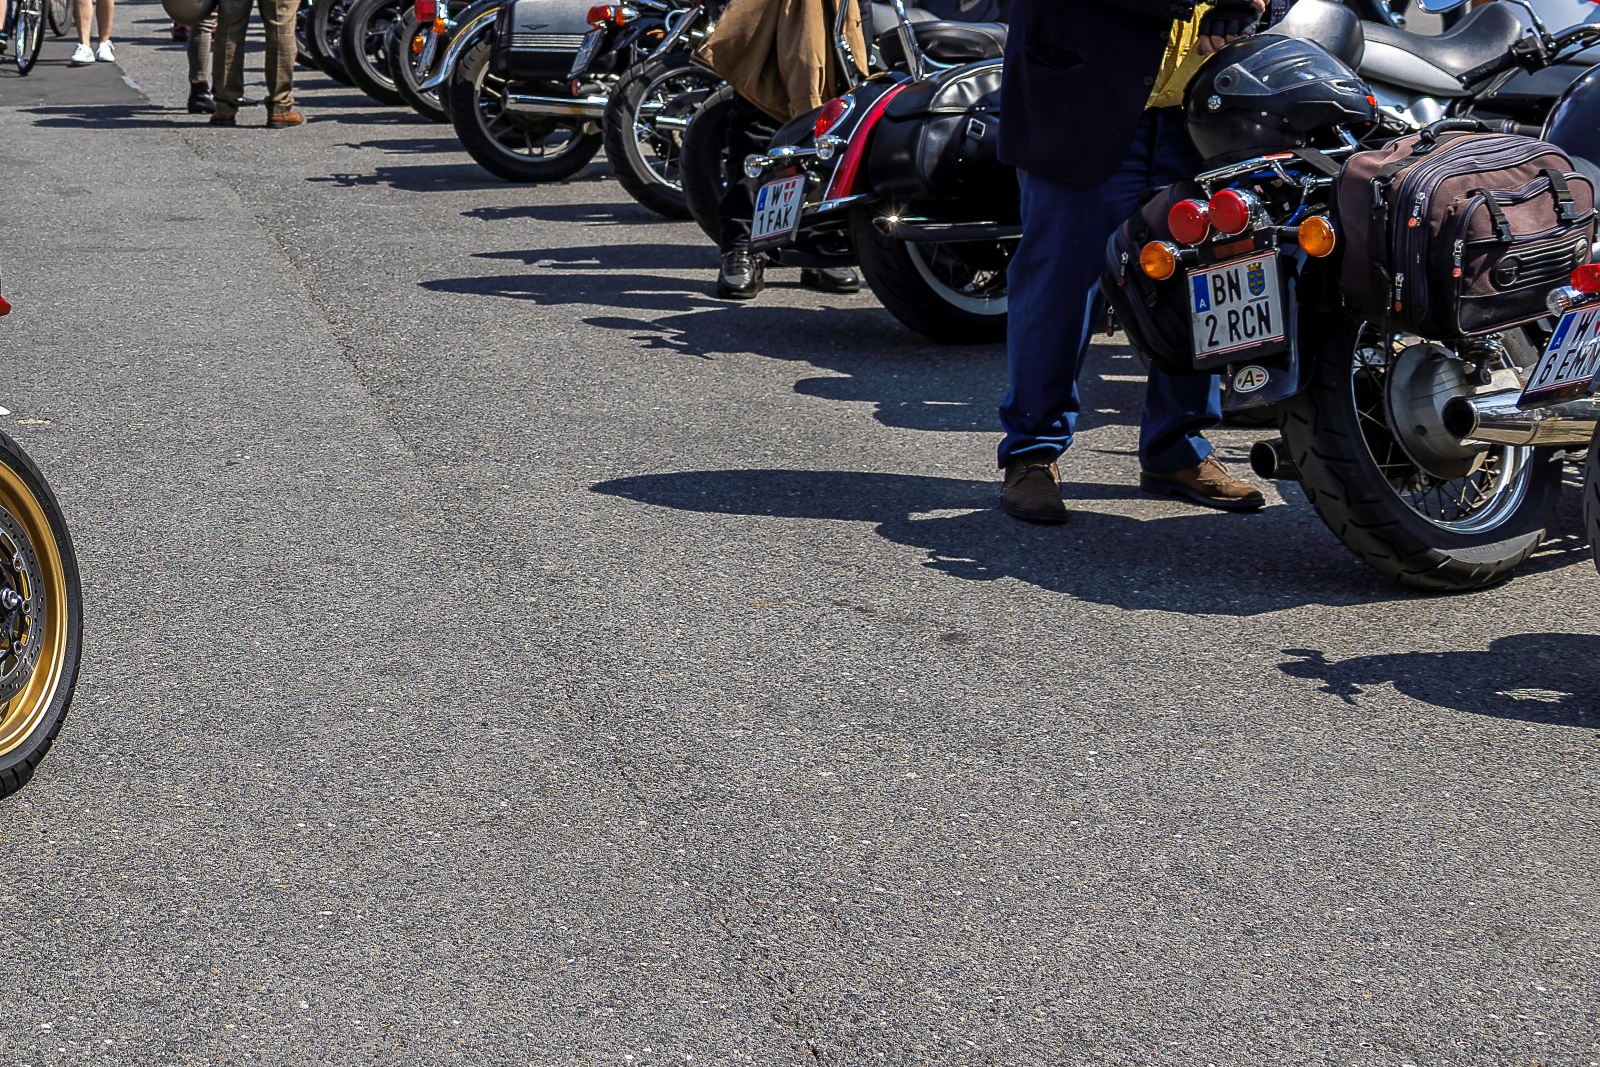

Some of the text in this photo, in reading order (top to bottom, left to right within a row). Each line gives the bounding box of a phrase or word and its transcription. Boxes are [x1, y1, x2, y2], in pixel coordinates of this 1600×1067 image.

[771, 184, 784, 206] W
[1199, 298, 1207, 308] A
[1211, 268, 1242, 307] BN
[1205, 301, 1271, 347] 2 RCN
[1572, 309, 1598, 343] W
[1240, 369, 1256, 388] A
[1538, 352, 1558, 384] 6
